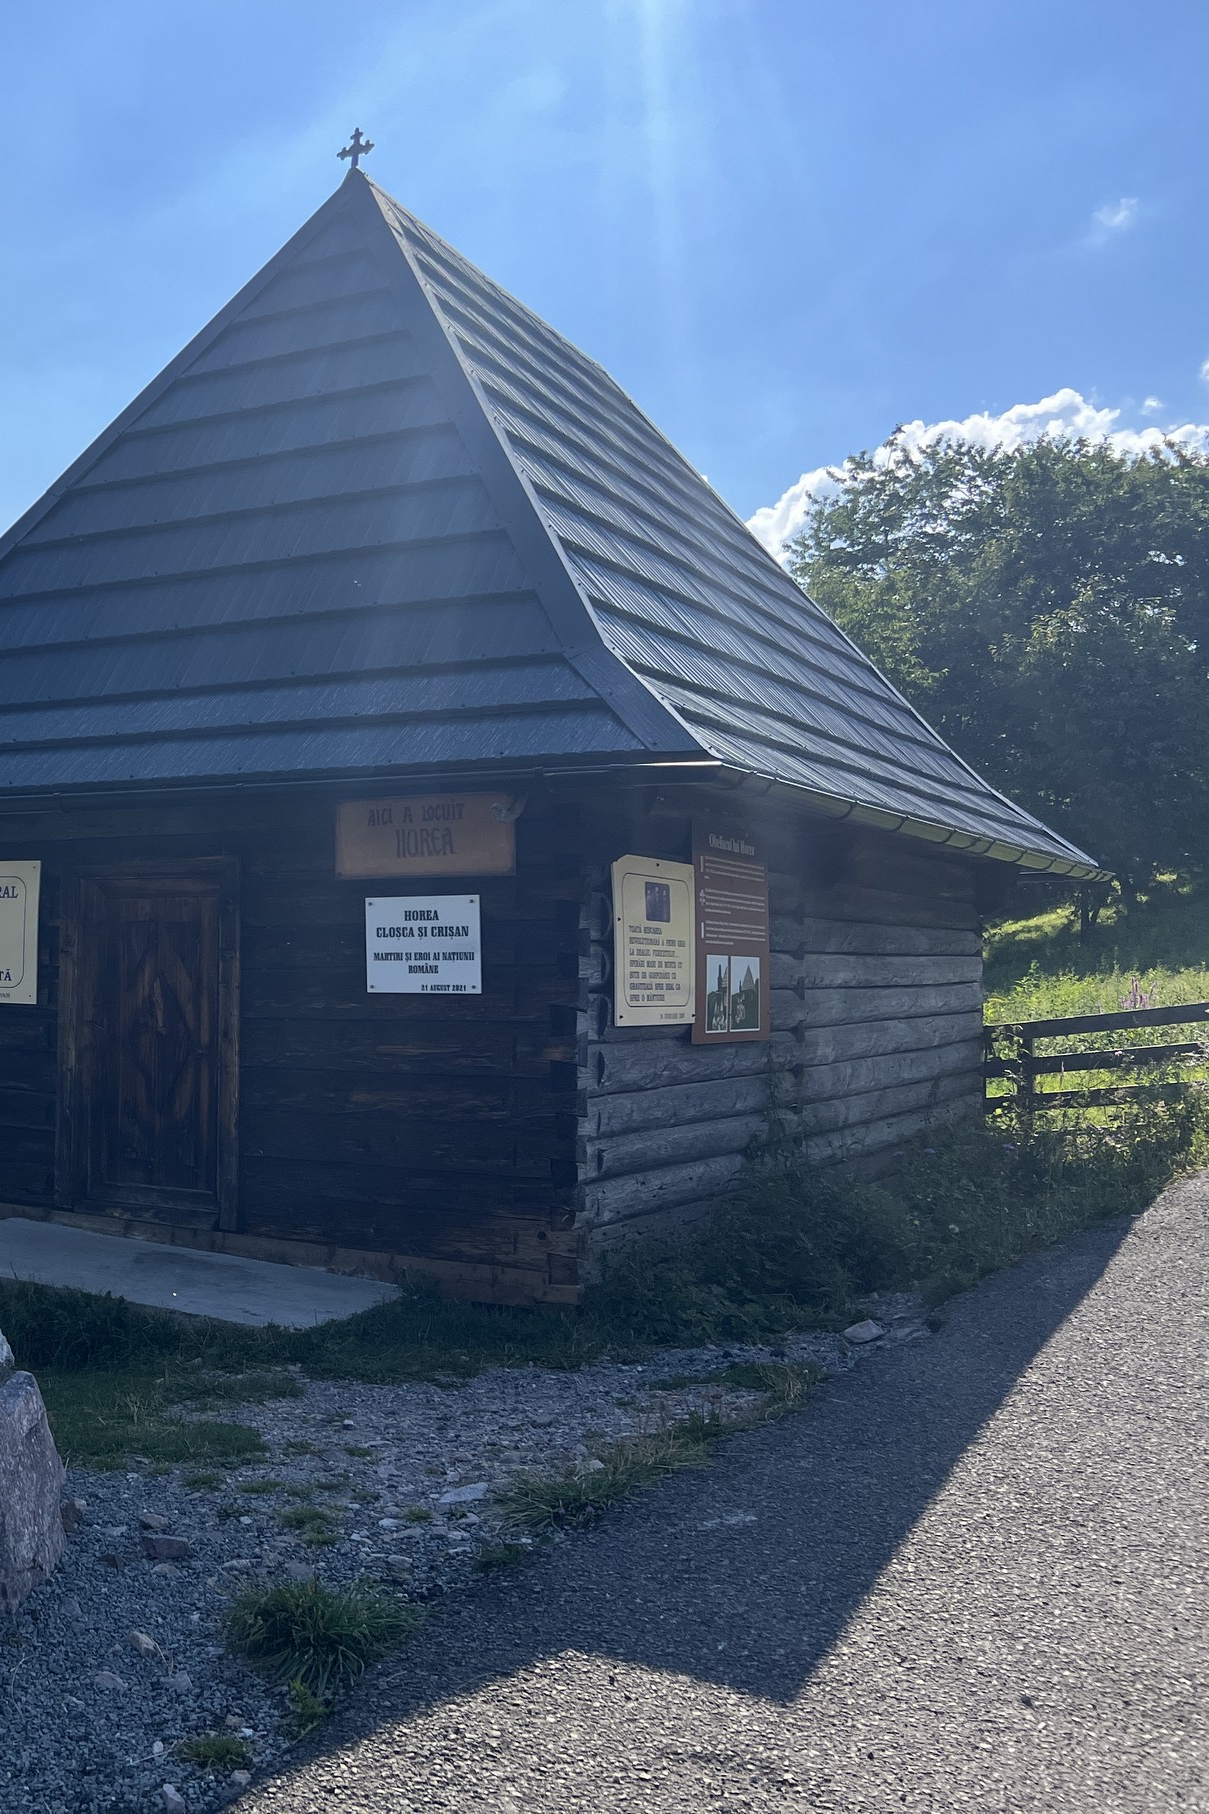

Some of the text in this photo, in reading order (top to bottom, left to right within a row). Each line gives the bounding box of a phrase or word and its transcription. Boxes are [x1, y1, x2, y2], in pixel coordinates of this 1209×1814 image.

[367, 799, 466, 827] AICI A LOCUIT
[395, 827, 456, 859] HOREA
[404, 910, 440, 921] HOREA
[373, 952, 403, 961] MARTIRI
[414, 952, 431, 961] EROI
[432, 951, 441, 961] AI
[408, 963, 439, 974] ROMÂNE
[430, 984, 451, 992] AUGUST
